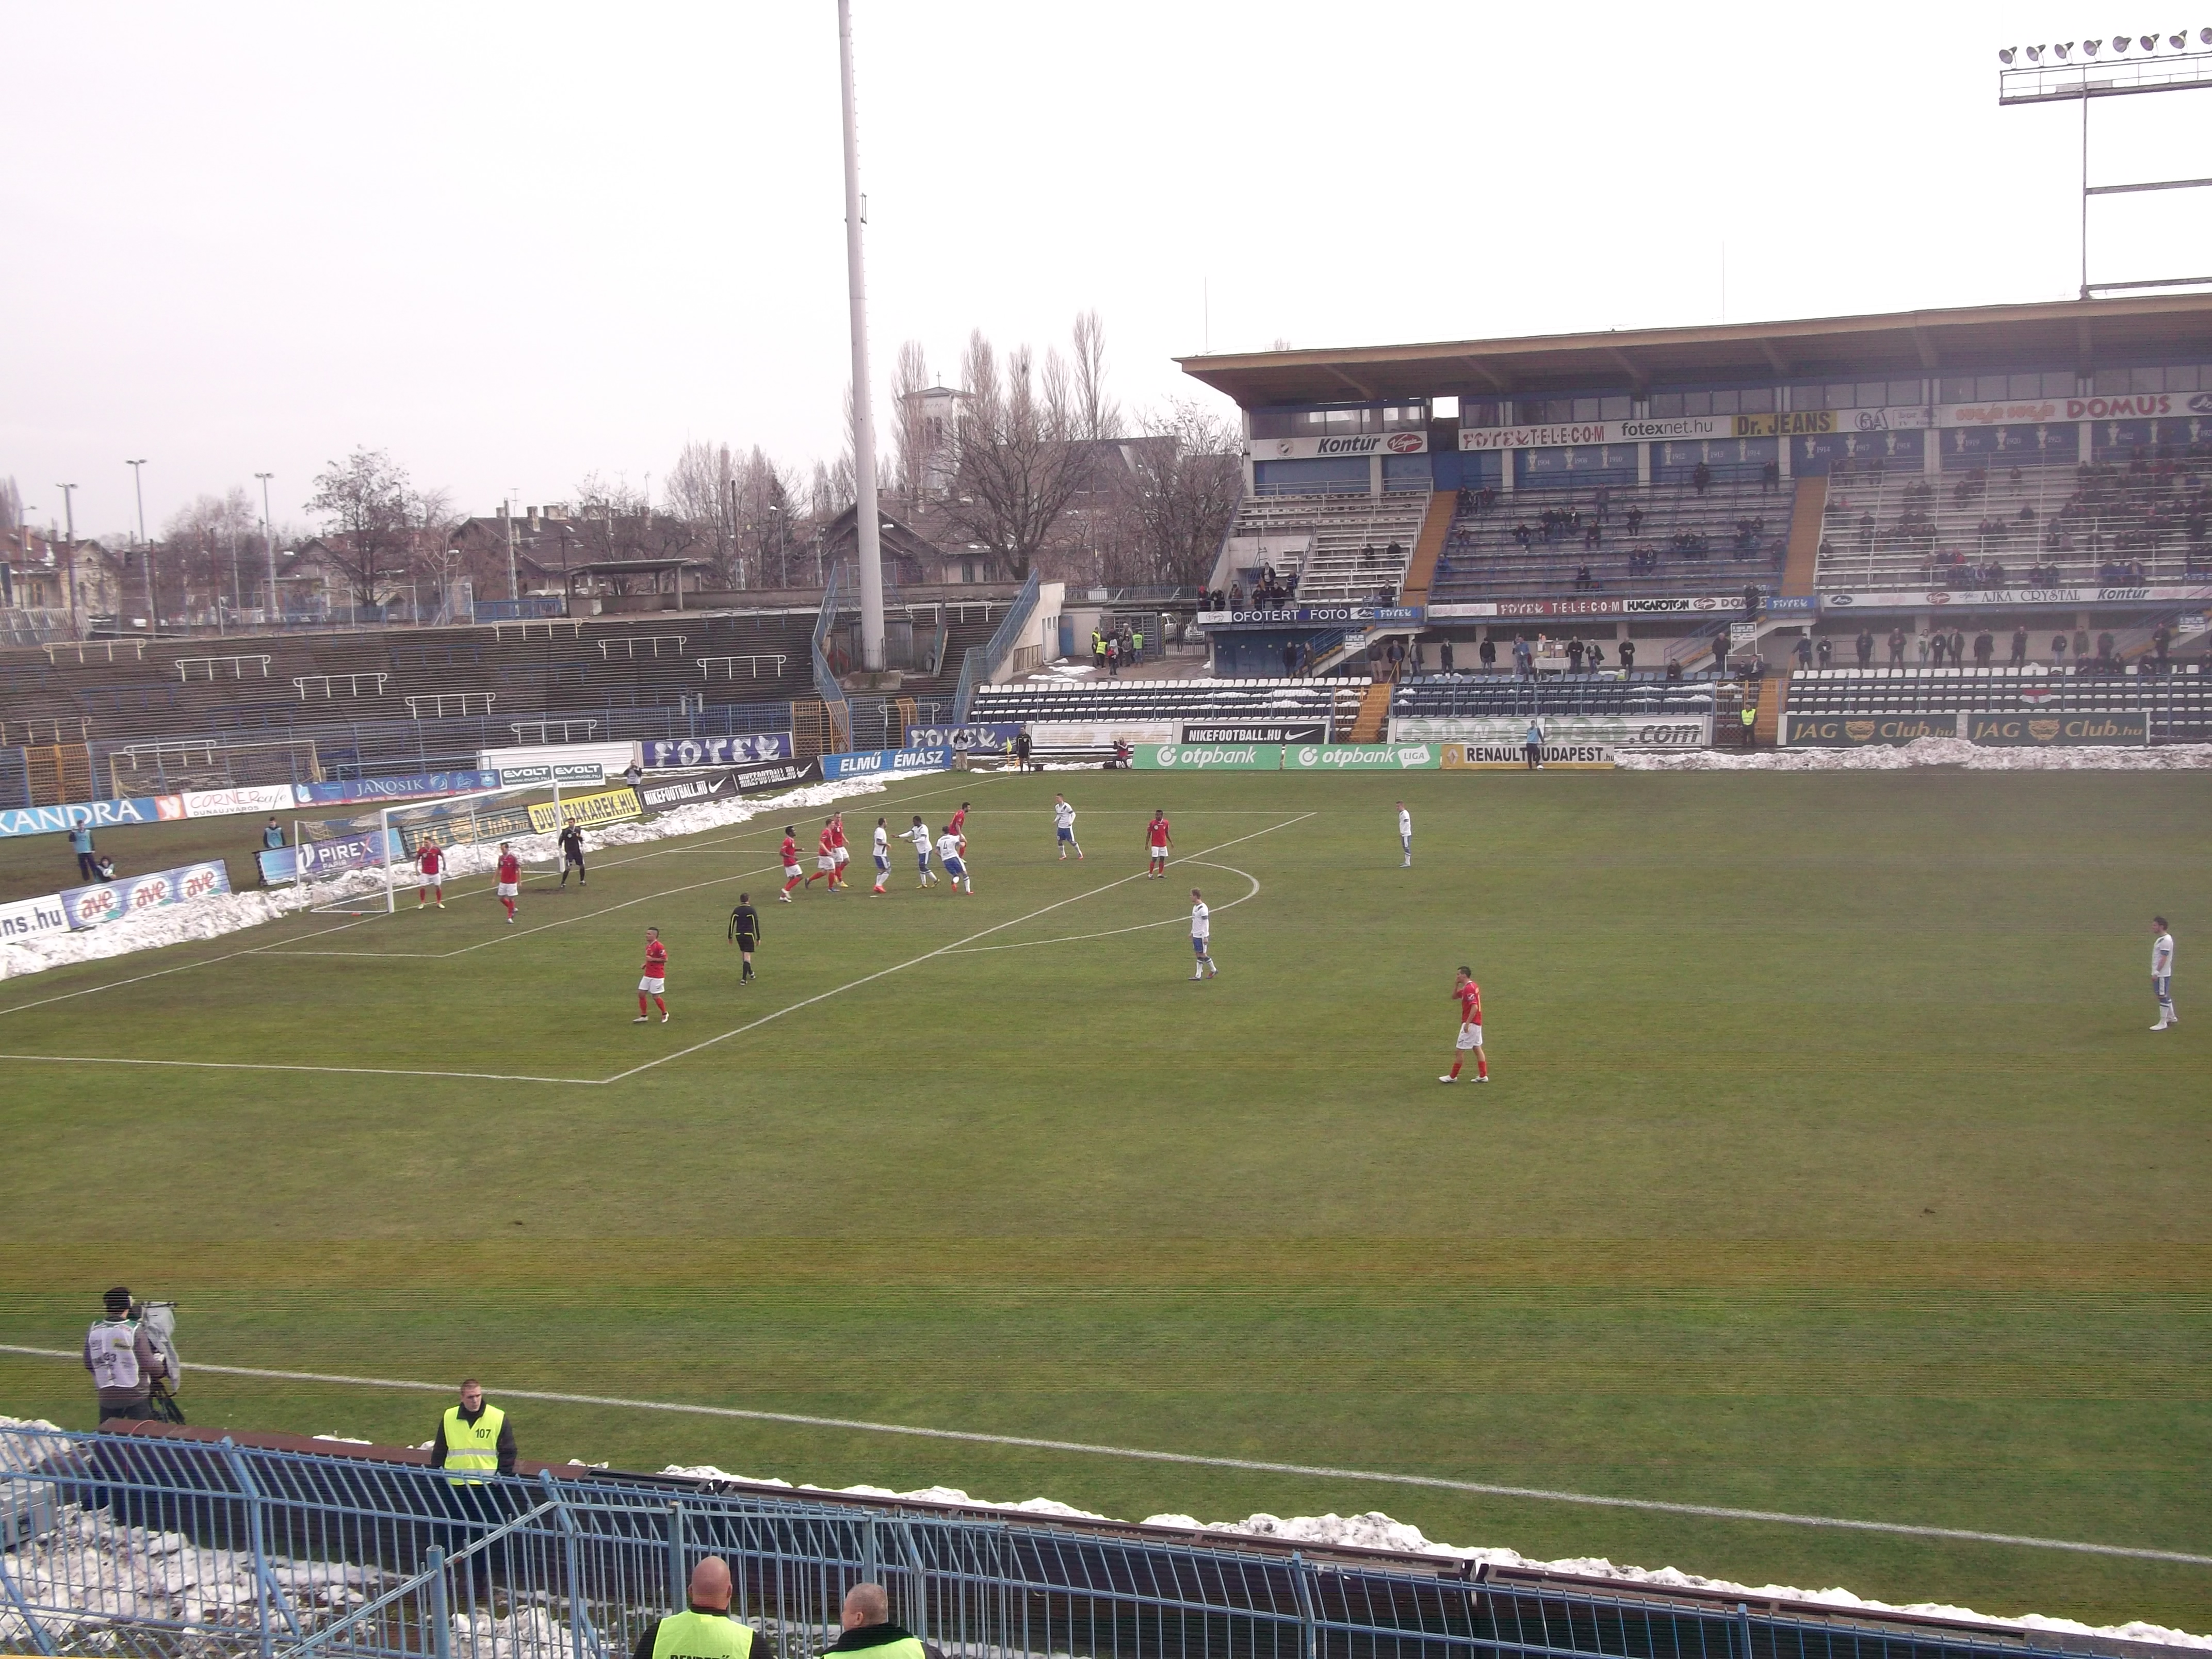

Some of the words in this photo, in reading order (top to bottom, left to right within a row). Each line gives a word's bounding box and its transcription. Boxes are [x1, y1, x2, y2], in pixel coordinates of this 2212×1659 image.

[2067, 395, 2171, 419] DOMUS
[1621, 419, 1713, 436] fotexnet.hu
[1737, 415, 1762, 434] Dr.
[1768, 412, 1830, 434] JEANS
[1317, 435, 1380, 453] Kontúr
[1981, 591, 2012, 603] AJKA
[2021, 589, 2080, 601] CRYSTAL
[1380, 609, 1412, 618] FOTEX
[1500, 603, 1544, 614] FOTEX
[1189, 728, 1281, 742] NIKEFOOTBALL.HU
[1793, 723, 1839, 740] JAG
[1880, 721, 1955, 737] Club.hu
[1973, 722, 2022, 740] JAG
[2064, 720, 2143, 737] Club.hu
[654, 736, 780, 767] FOTEX
[840, 751, 881, 772] ELMŰ
[893, 748, 944, 768] ÉMÁSZ
[1181, 746, 1258, 768] otpbank
[1322, 746, 1395, 768] otpbank
[1403, 752, 1425, 760] LIGA
[1467, 747, 1528, 762] RENAULT
[503, 767, 548, 778] EVOLT
[555, 766, 599, 775] EVOLT
[356, 778, 425, 797] JANOSIK
[643, 780, 709, 806] NIKEFOOTBALL.HU
[193, 805, 259, 816] DUNAÚJVÁROS
[318, 836, 373, 862] PIREX
[186, 871, 215, 898] ave
[136, 880, 166, 909] ave
[79, 890, 113, 920] ave
[0, 906, 62, 937] ns.hu
[475, 1428, 491, 1439] 107
